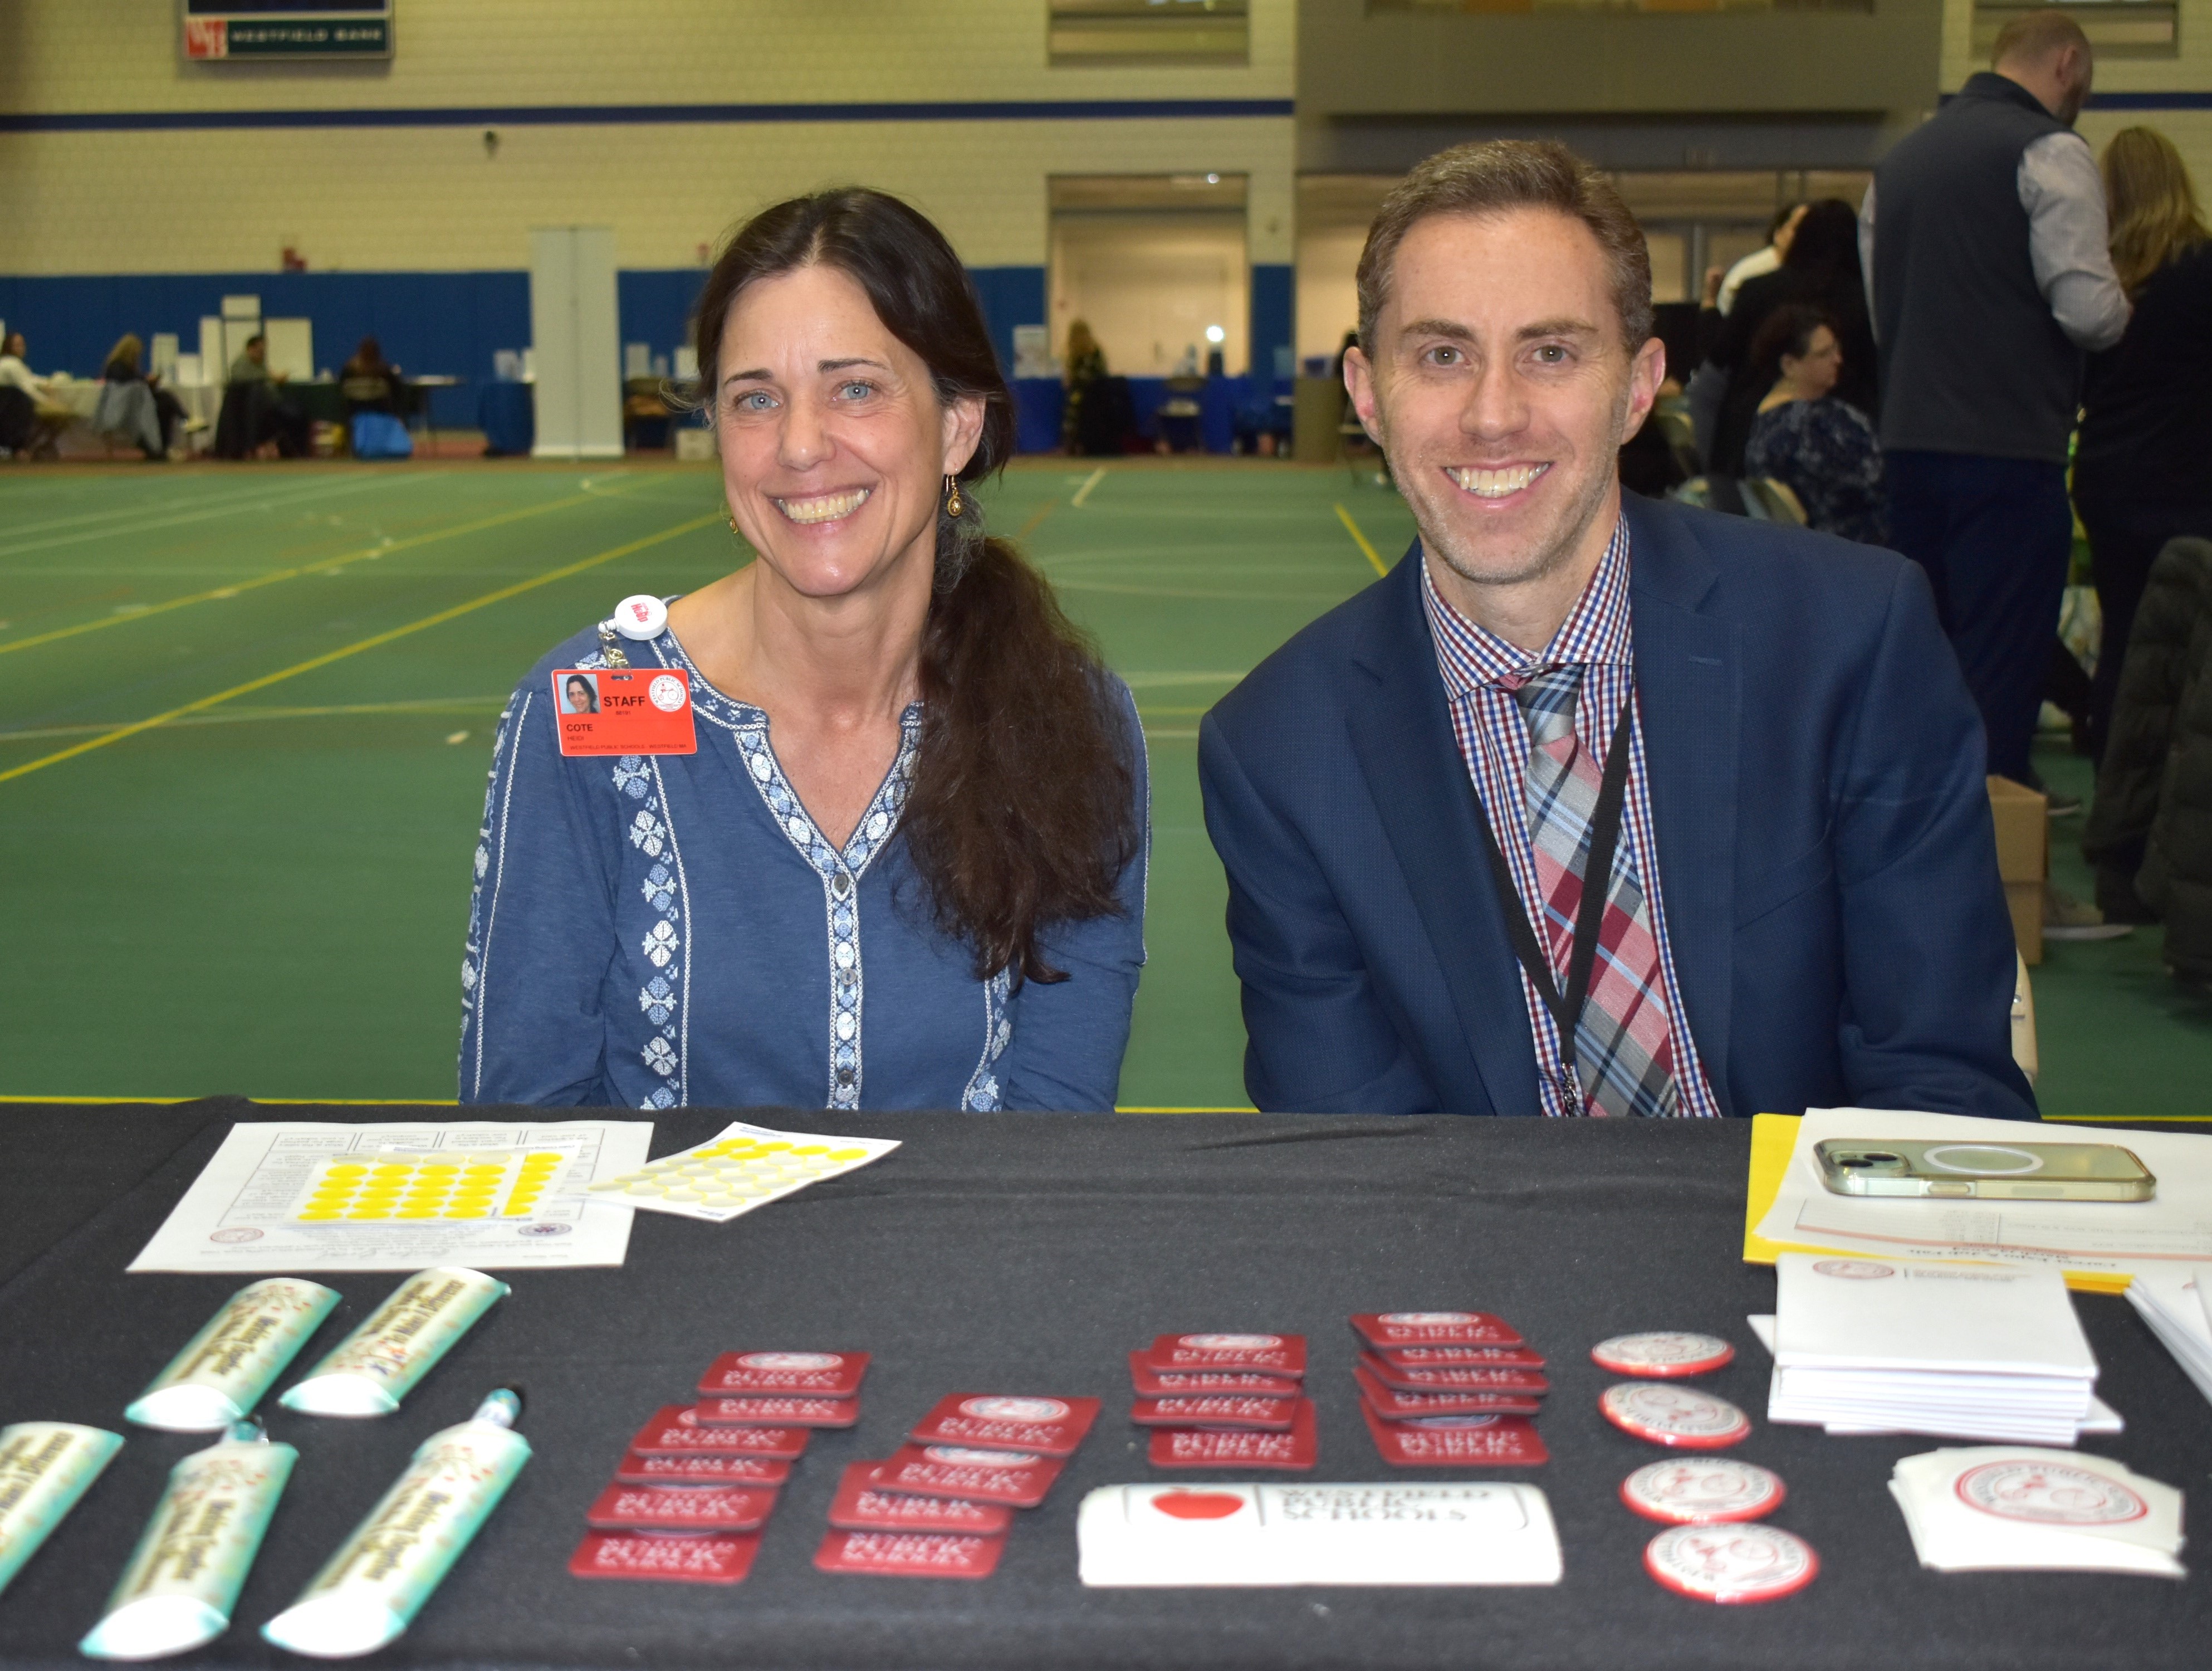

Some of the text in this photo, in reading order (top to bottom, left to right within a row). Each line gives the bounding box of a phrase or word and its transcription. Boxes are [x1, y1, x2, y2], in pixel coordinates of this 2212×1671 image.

[231, 28, 383, 42] WESTFIELD BANK
[604, 696, 645, 707] STAFF
[1280, 1489, 1491, 1498] WESTFIELD
[1283, 1497, 1420, 1507] PUBLIC
[1283, 1506, 1469, 1521] SCHOOLS
